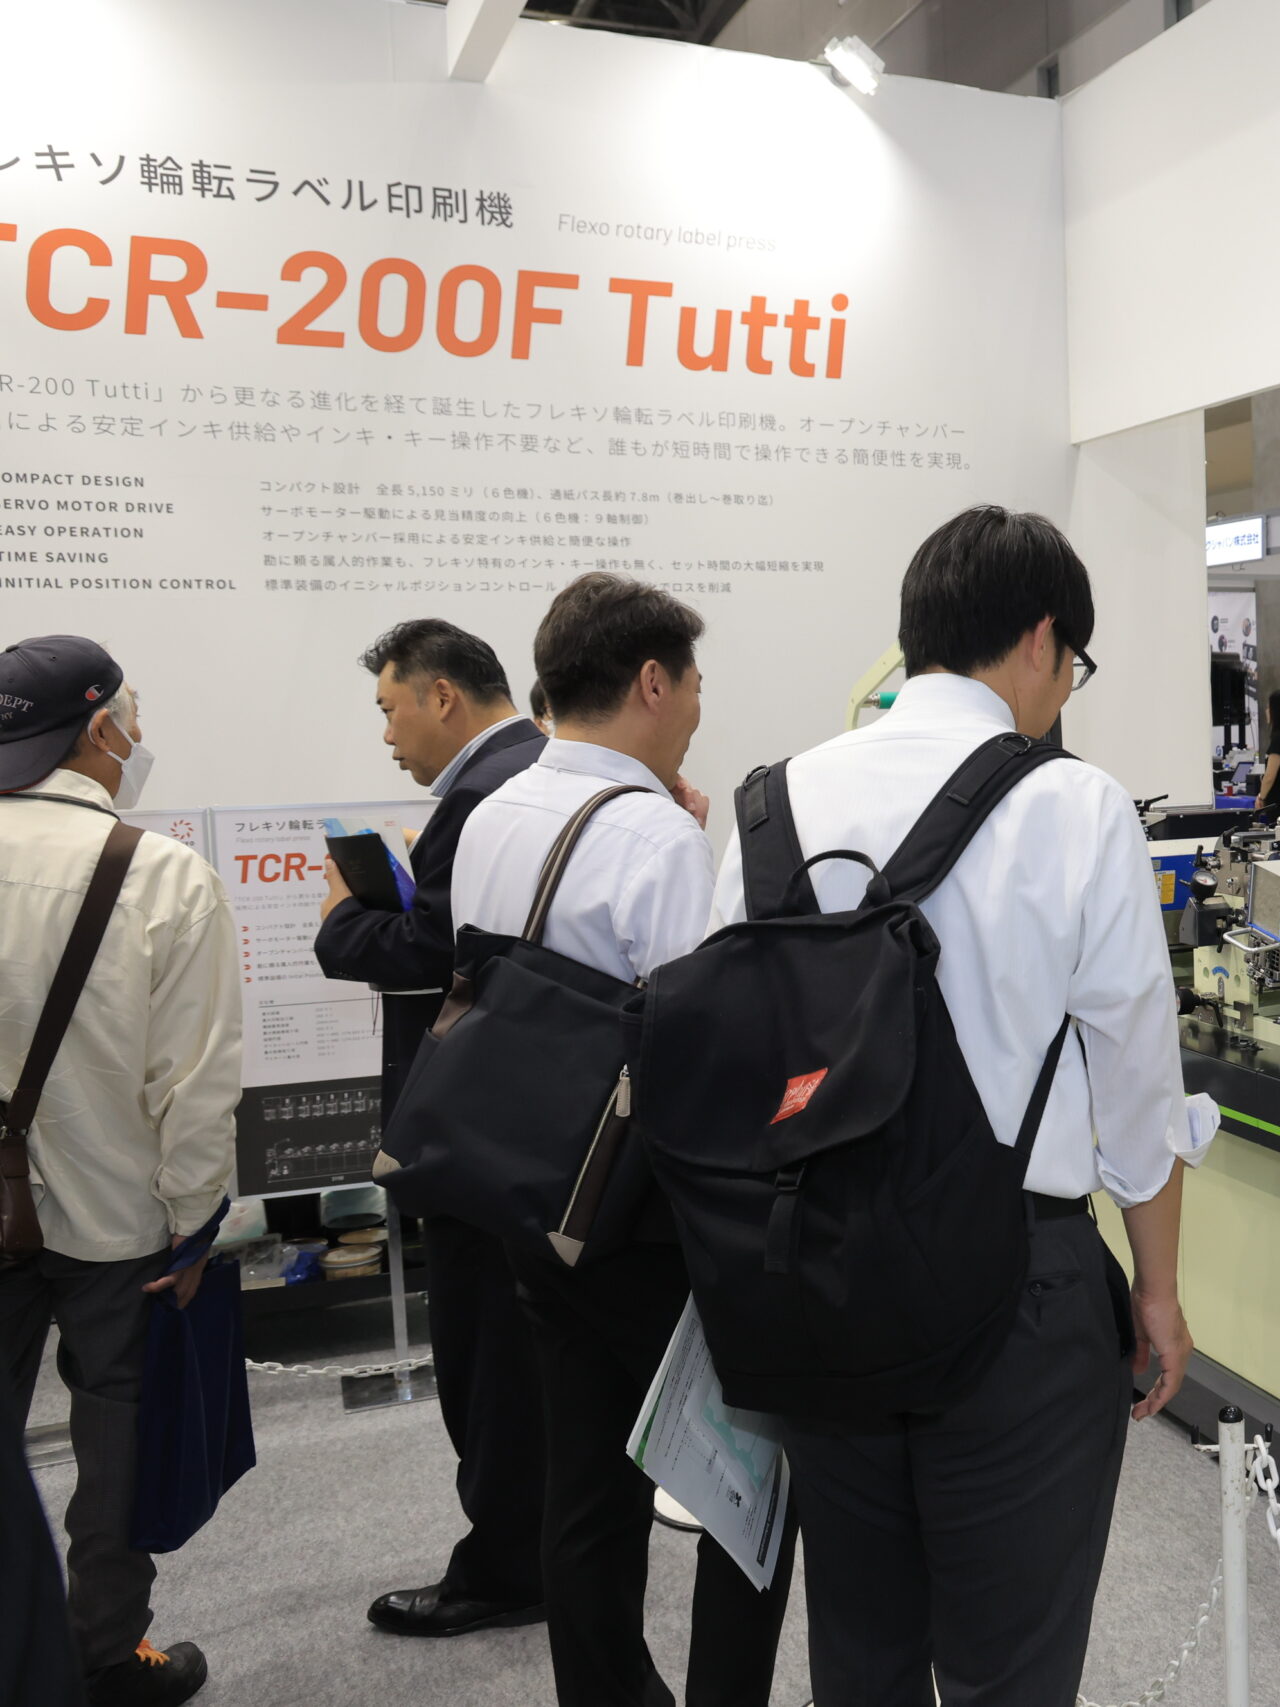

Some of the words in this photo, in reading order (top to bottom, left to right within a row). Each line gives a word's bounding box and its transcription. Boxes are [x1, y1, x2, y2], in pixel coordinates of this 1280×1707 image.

[558, 213, 610, 236] Flexo
[615, 220, 674, 246] rotary
[676, 226, 722, 247] label
[726, 231, 777, 252] press
[608, 277, 849, 379] Tutti
[82, 475, 145, 487] DESIGN
[0, 498, 49, 511] ERVO
[57, 500, 118, 512] MOTOR
[125, 502, 175, 514] DRIVE
[44, 526, 145, 538] OPERATION
[45, 552, 109, 564] SAVING
[70, 577, 152, 589] POSITION
[159, 578, 237, 590] CONTROL
[234, 852, 331, 884] TCR-
